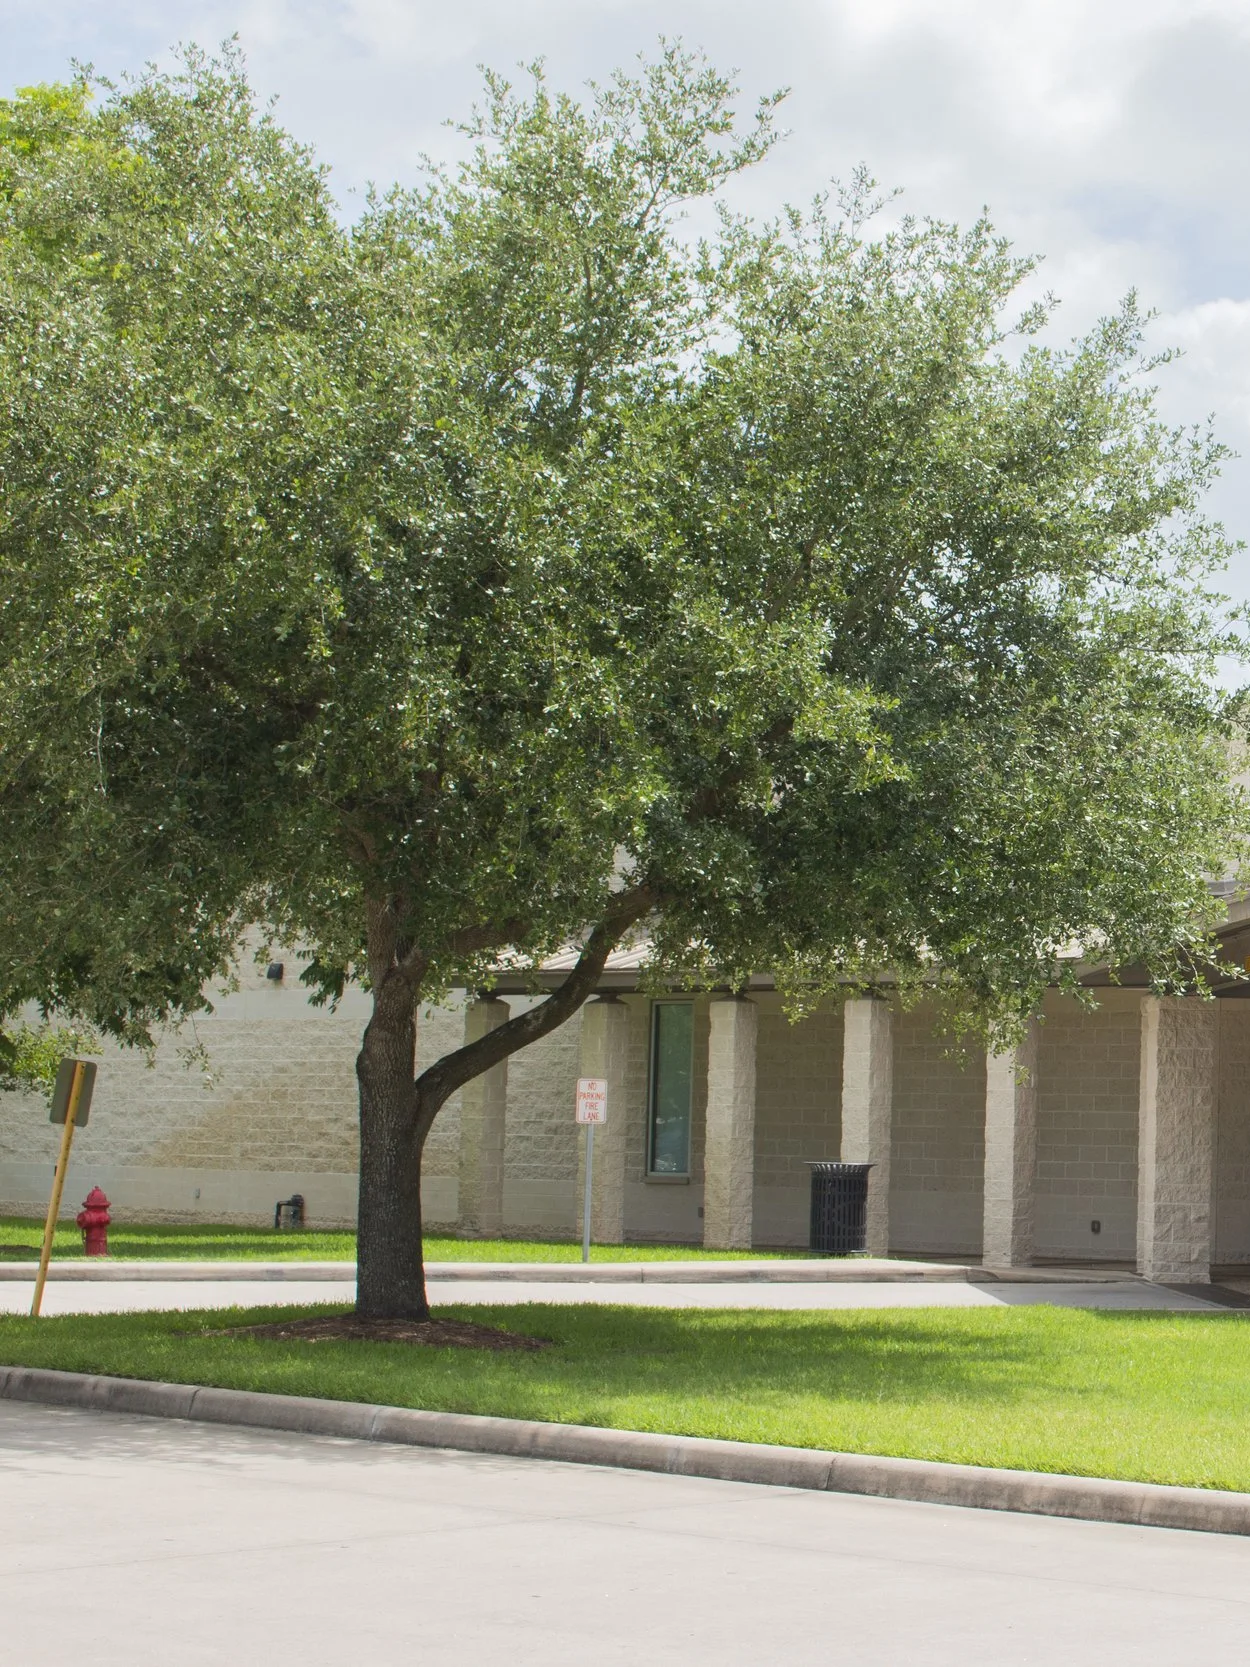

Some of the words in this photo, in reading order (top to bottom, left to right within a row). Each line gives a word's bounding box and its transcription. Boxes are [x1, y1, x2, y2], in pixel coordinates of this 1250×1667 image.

[588, 1081, 597, 1090] NO
[579, 1091, 605, 1101] PARKING
[585, 1101, 600, 1110] FIRE
[583, 1111, 600, 1120] LANE
